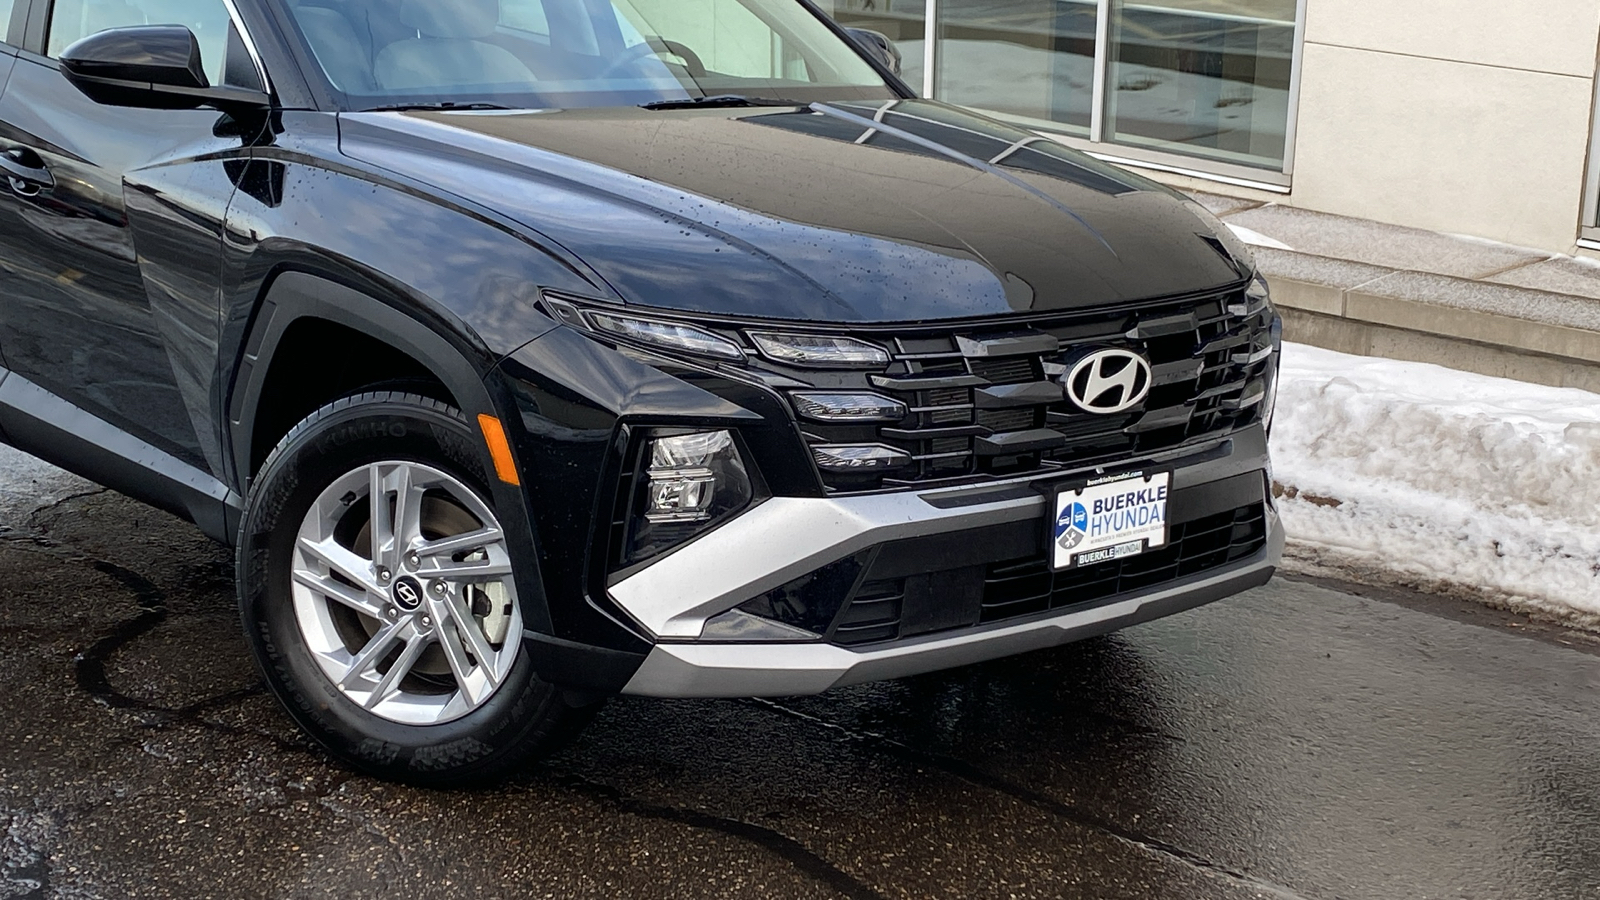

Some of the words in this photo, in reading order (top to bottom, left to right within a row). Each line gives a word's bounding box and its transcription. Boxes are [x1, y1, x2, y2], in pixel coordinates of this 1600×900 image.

[1086, 470, 1143, 486] buerklehyundai.com
[1093, 485, 1167, 515] BUERKLE
[1091, 502, 1167, 537] HYUNDAI
[1079, 548, 1115, 564] BUERKLE
[1115, 542, 1141, 556] HYUNDAI
